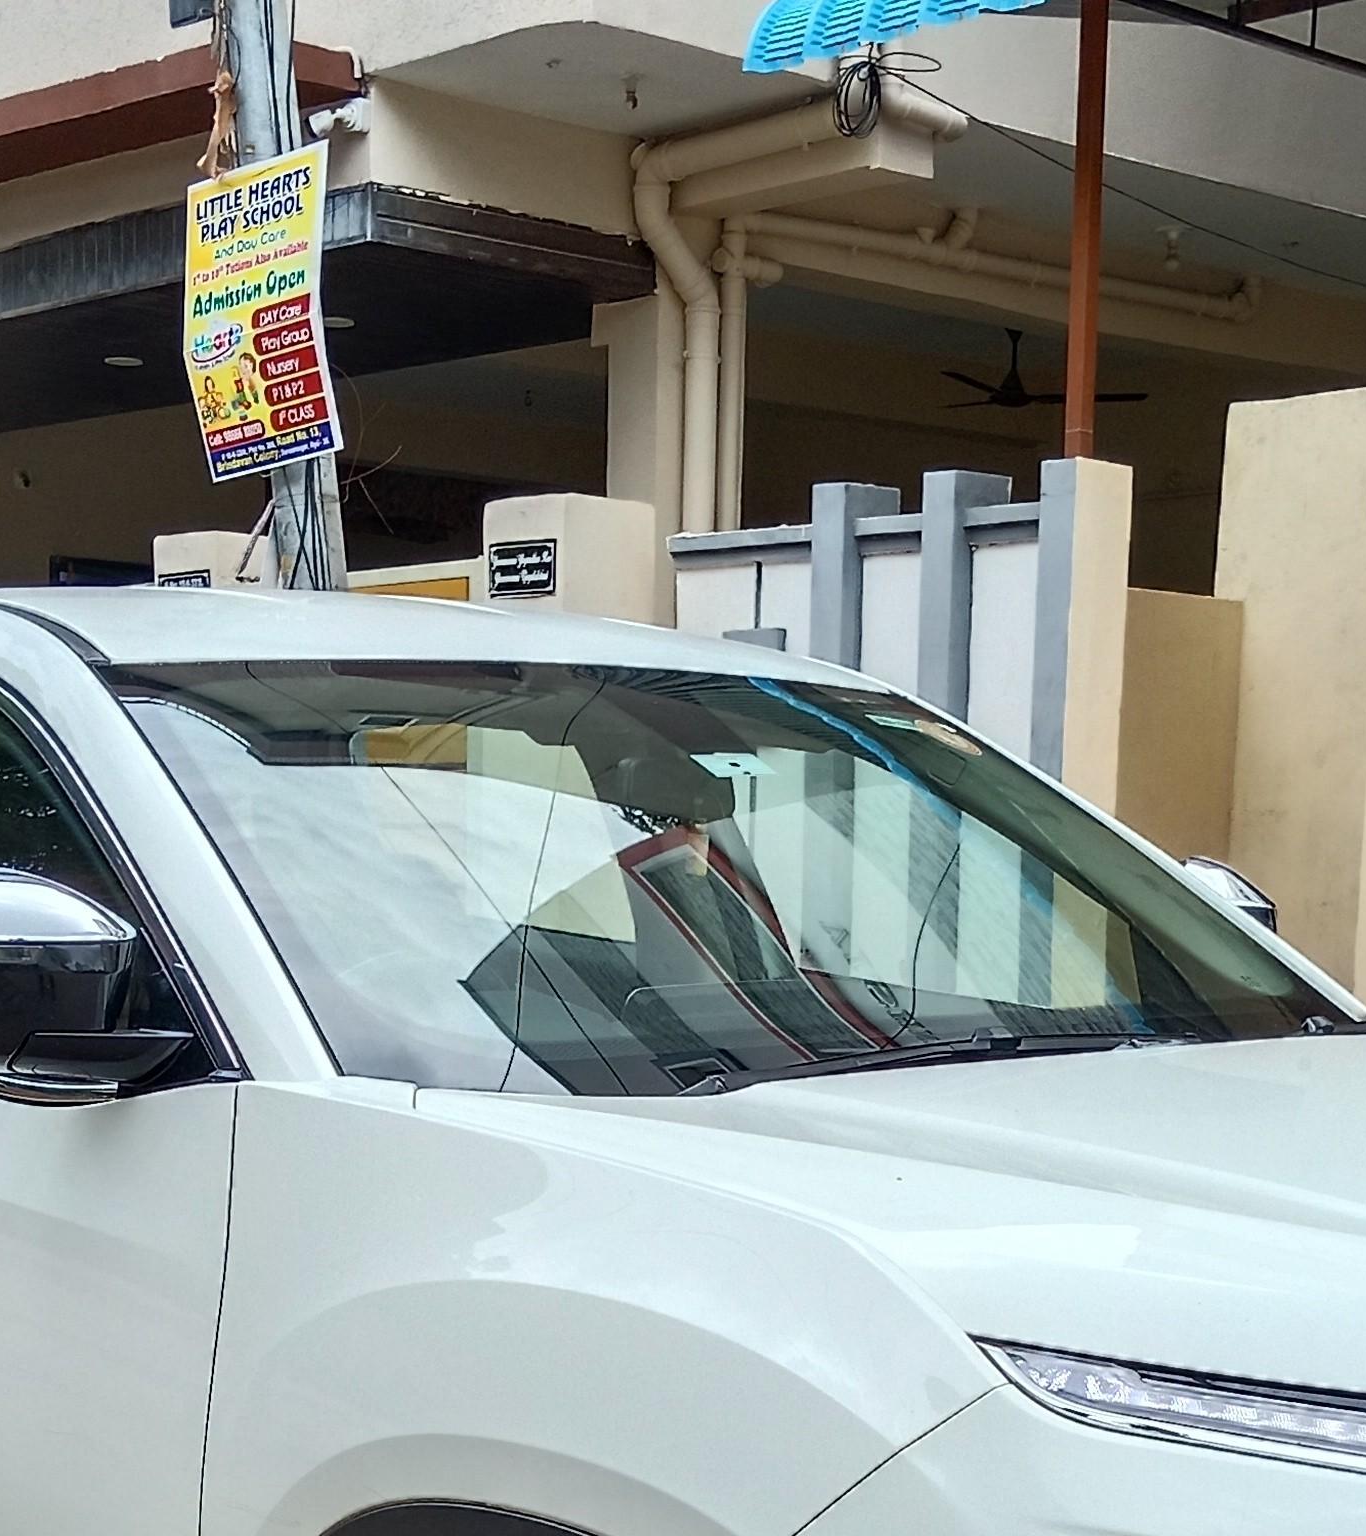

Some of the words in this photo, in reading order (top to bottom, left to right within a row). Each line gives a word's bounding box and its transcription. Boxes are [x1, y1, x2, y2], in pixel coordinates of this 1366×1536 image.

[196, 188, 243, 223] LITTLE
[248, 166, 312, 206] HEARTS
[201, 214, 238, 244] PLAY
[242, 193, 304, 230] SCHOOL
[215, 242, 234, 259] And
[260, 229, 287, 245] Care
[254, 251, 271, 266] Also
[193, 279, 262, 319] Admission
[266, 269, 305, 297] Open
[259, 310, 280, 327] DAY
[279, 303, 302, 320] Care
[260, 336, 281, 352] Play
[281, 328, 310, 346] Group
[266, 357, 300, 377] Nursery
[287, 404, 316, 424] CLASS
